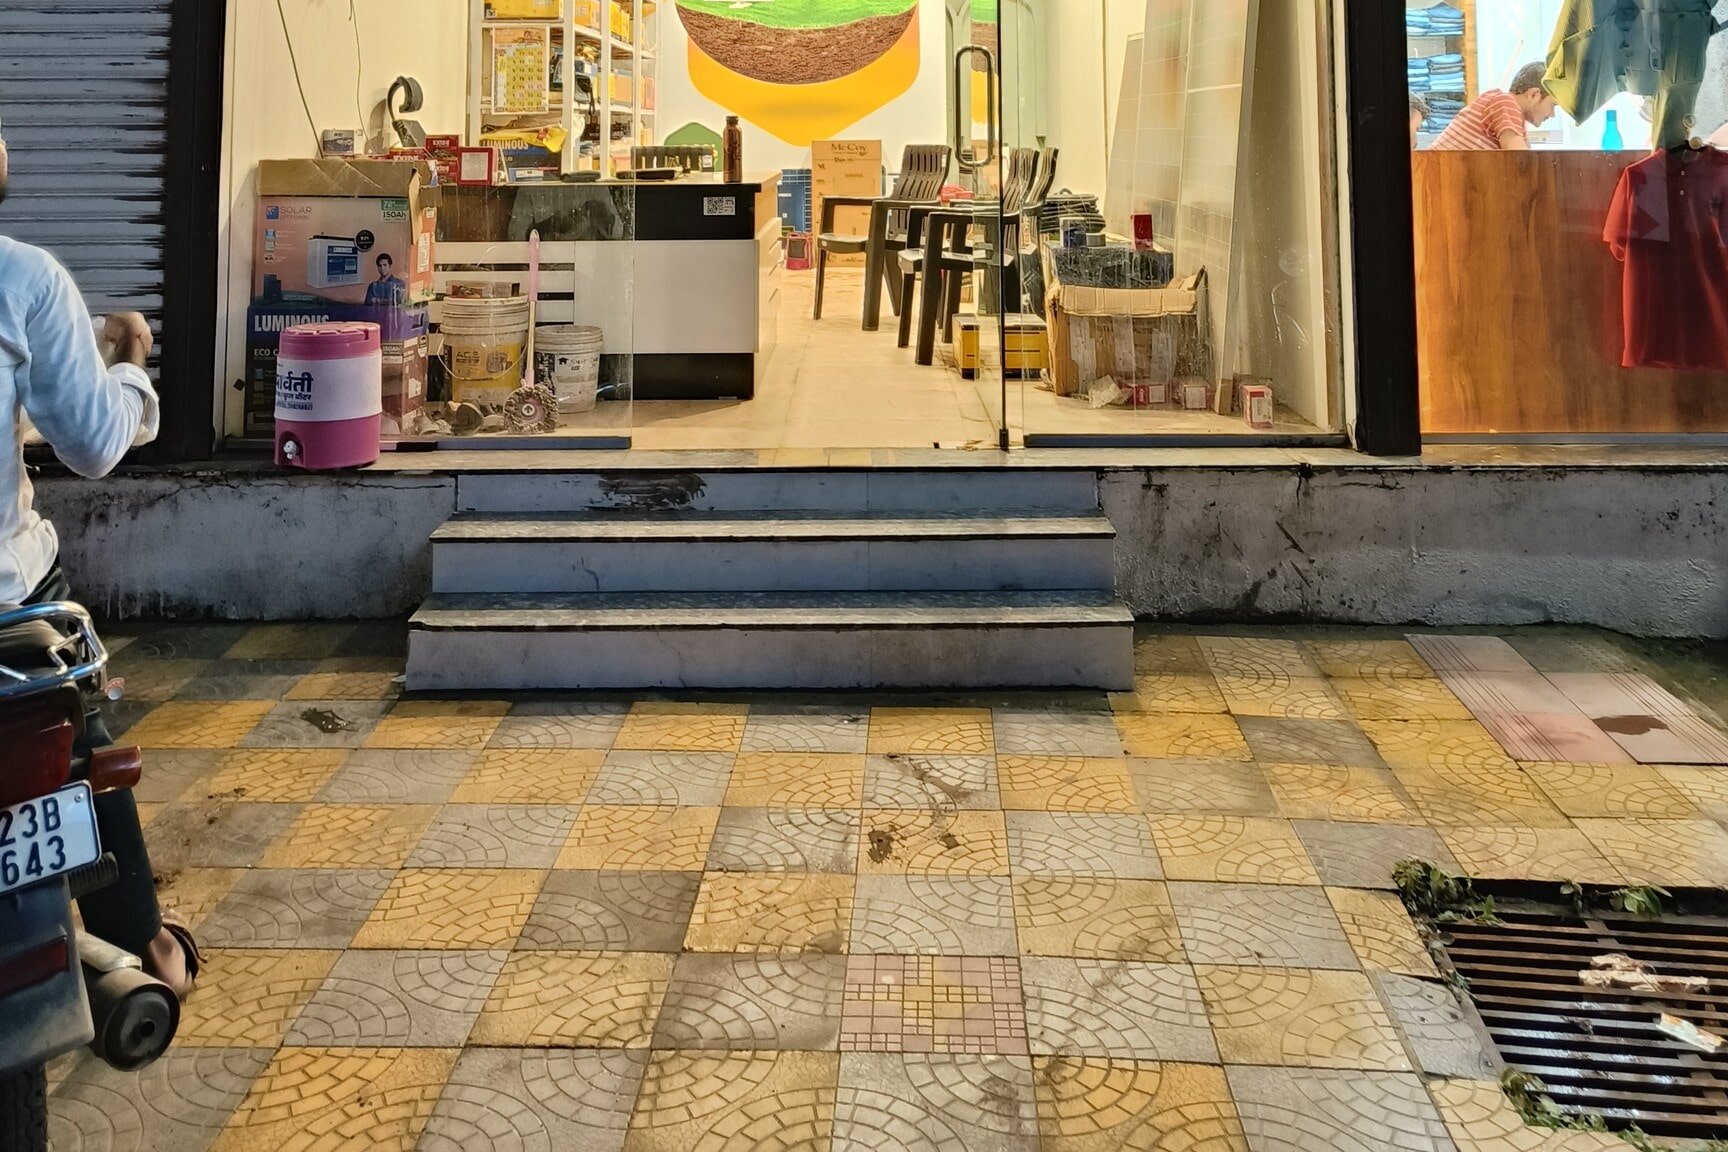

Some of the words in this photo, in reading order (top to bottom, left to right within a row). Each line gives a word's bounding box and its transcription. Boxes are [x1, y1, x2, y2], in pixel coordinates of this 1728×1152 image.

[280, 206, 312, 214] SOLAR
[254, 349, 271, 357] ECO
[1, 835, 67, 885] 643
